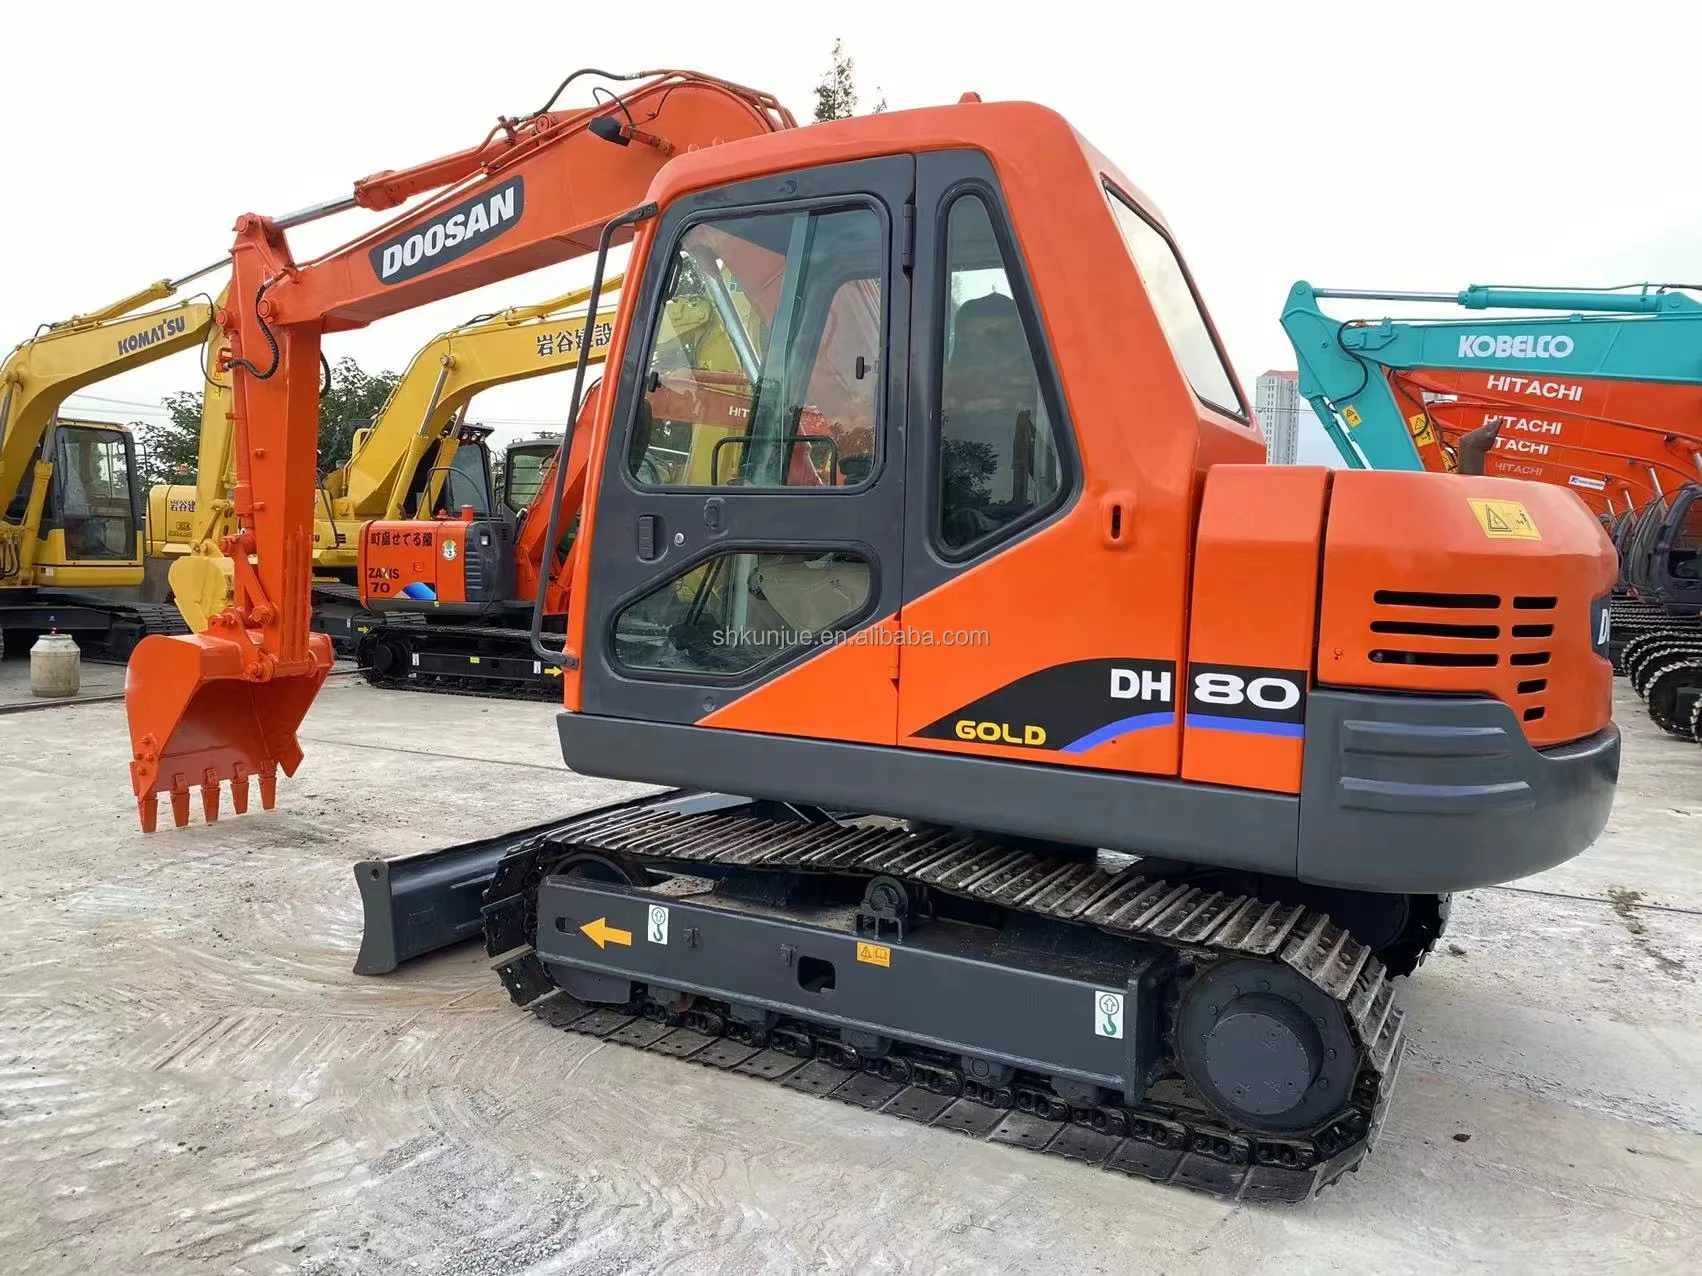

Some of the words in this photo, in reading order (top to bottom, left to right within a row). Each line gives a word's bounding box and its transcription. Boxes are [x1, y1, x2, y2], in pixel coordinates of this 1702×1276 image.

[381, 186, 515, 279] DOOSAN
[117, 316, 186, 356] KOMATSU
[1458, 334, 1575, 358] KOBELCO
[1486, 374, 1583, 401] HITACHI
[1482, 413, 1562, 435] HTACHI
[1494, 436, 1550, 455] TACHI
[1495, 461, 1544, 476] HITACHI
[370, 582, 391, 593] 70
[1110, 668, 1172, 702] DH
[1193, 671, 1301, 710] 80
[955, 719, 1047, 746] GOLD
